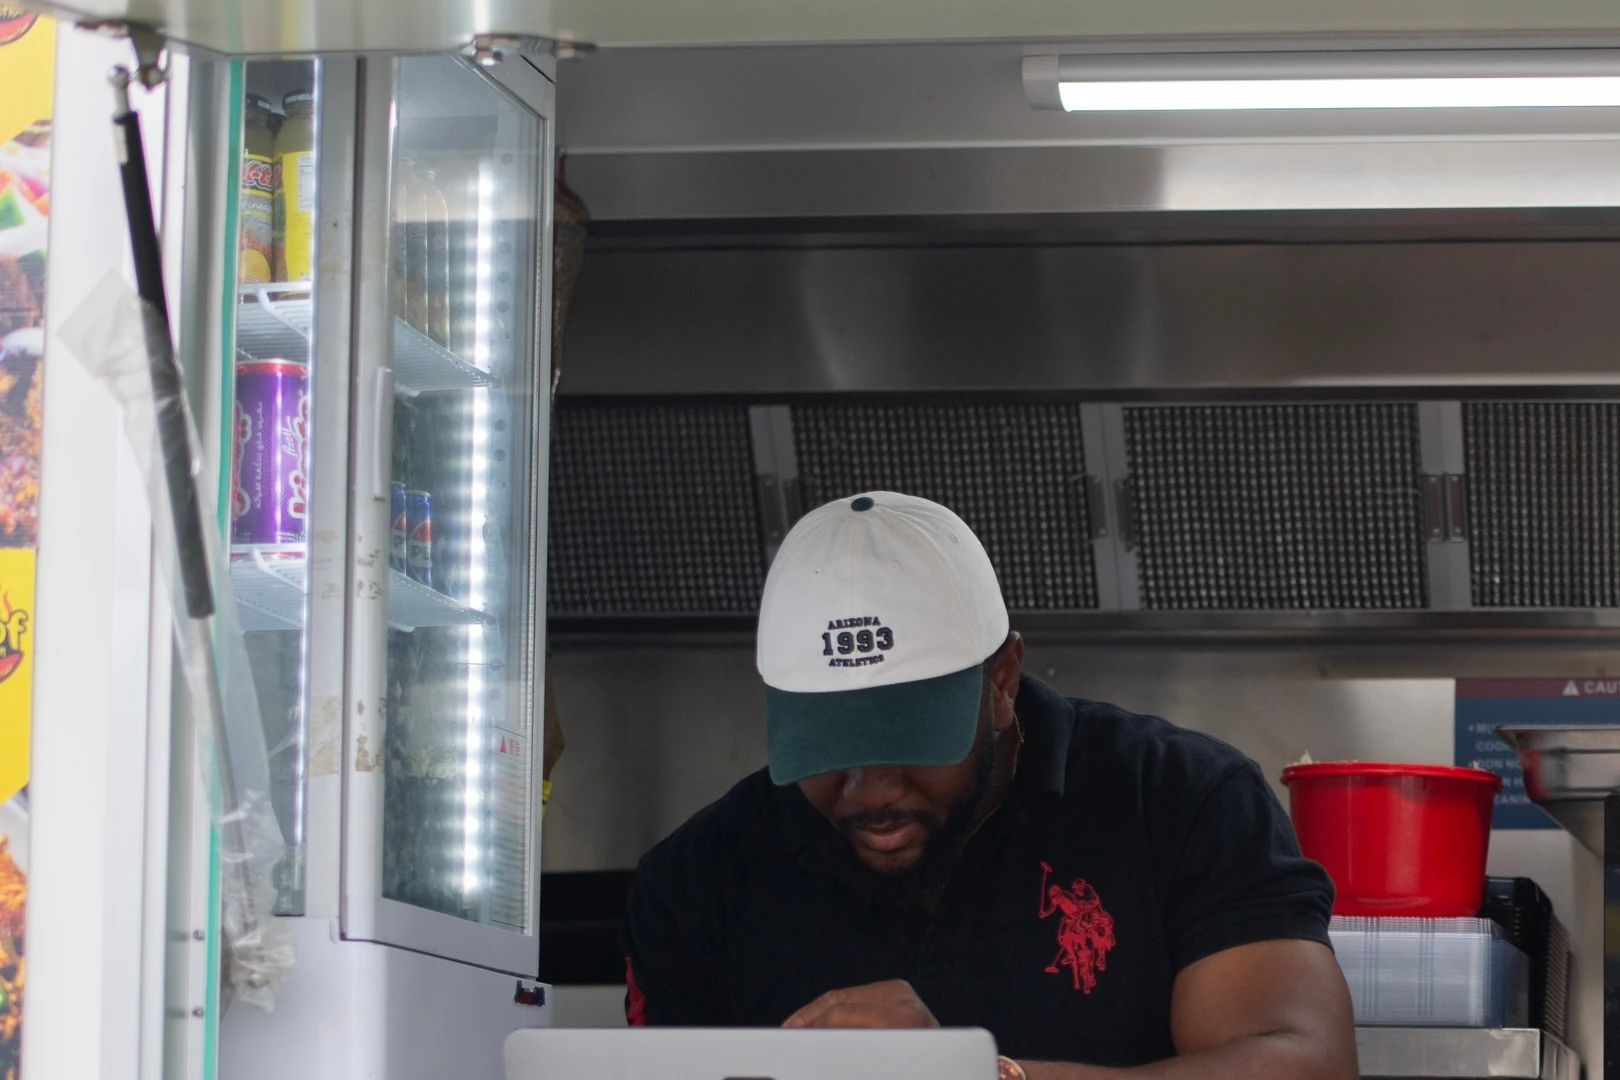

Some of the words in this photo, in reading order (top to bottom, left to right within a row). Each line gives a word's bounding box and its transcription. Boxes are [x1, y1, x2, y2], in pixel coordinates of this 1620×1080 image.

[828, 616, 881, 630] ARIZONA
[822, 627, 894, 656] 1993
[829, 654, 885, 667] ATHLETICS
